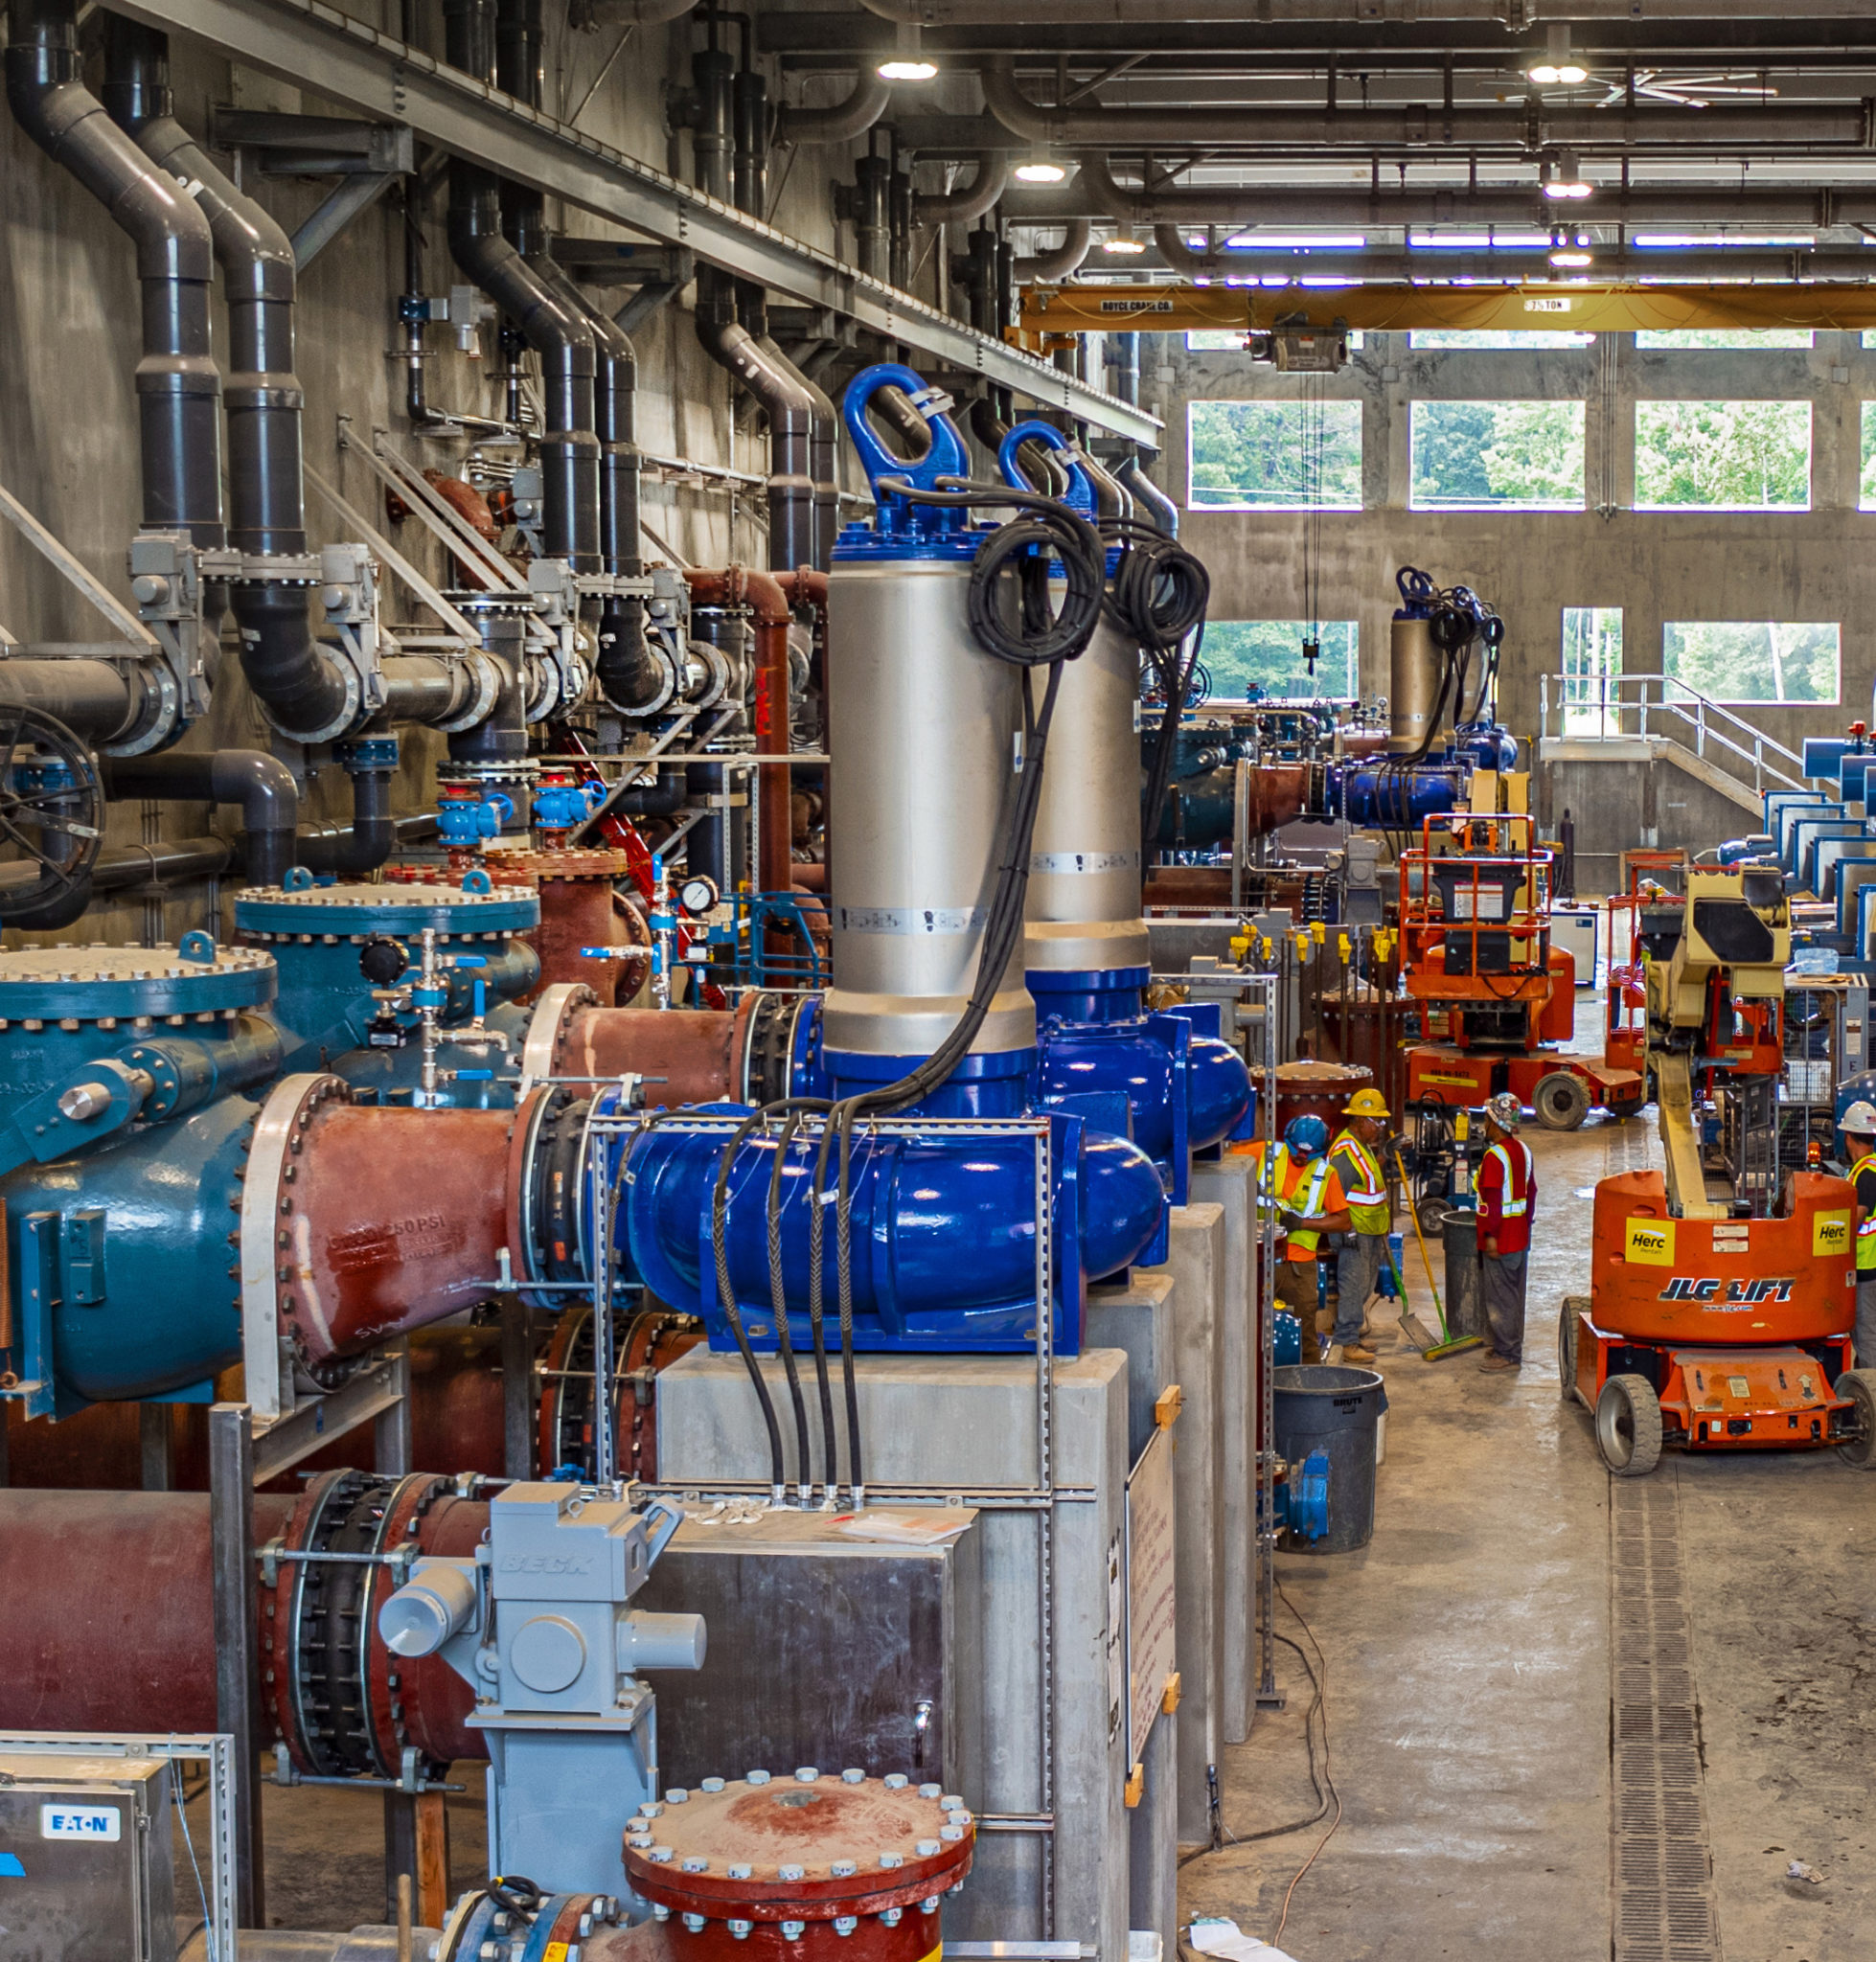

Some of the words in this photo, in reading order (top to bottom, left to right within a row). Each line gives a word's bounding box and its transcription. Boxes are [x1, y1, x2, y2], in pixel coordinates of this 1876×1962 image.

[1157, 302, 1171, 310] CO.
[1819, 1226, 1845, 1239] Herc
[1633, 1234, 1665, 1248] Herc
[1658, 1278, 1722, 1302] JLG
[1726, 1277, 1796, 1303] LIFT
[499, 1555, 594, 1575] BECK
